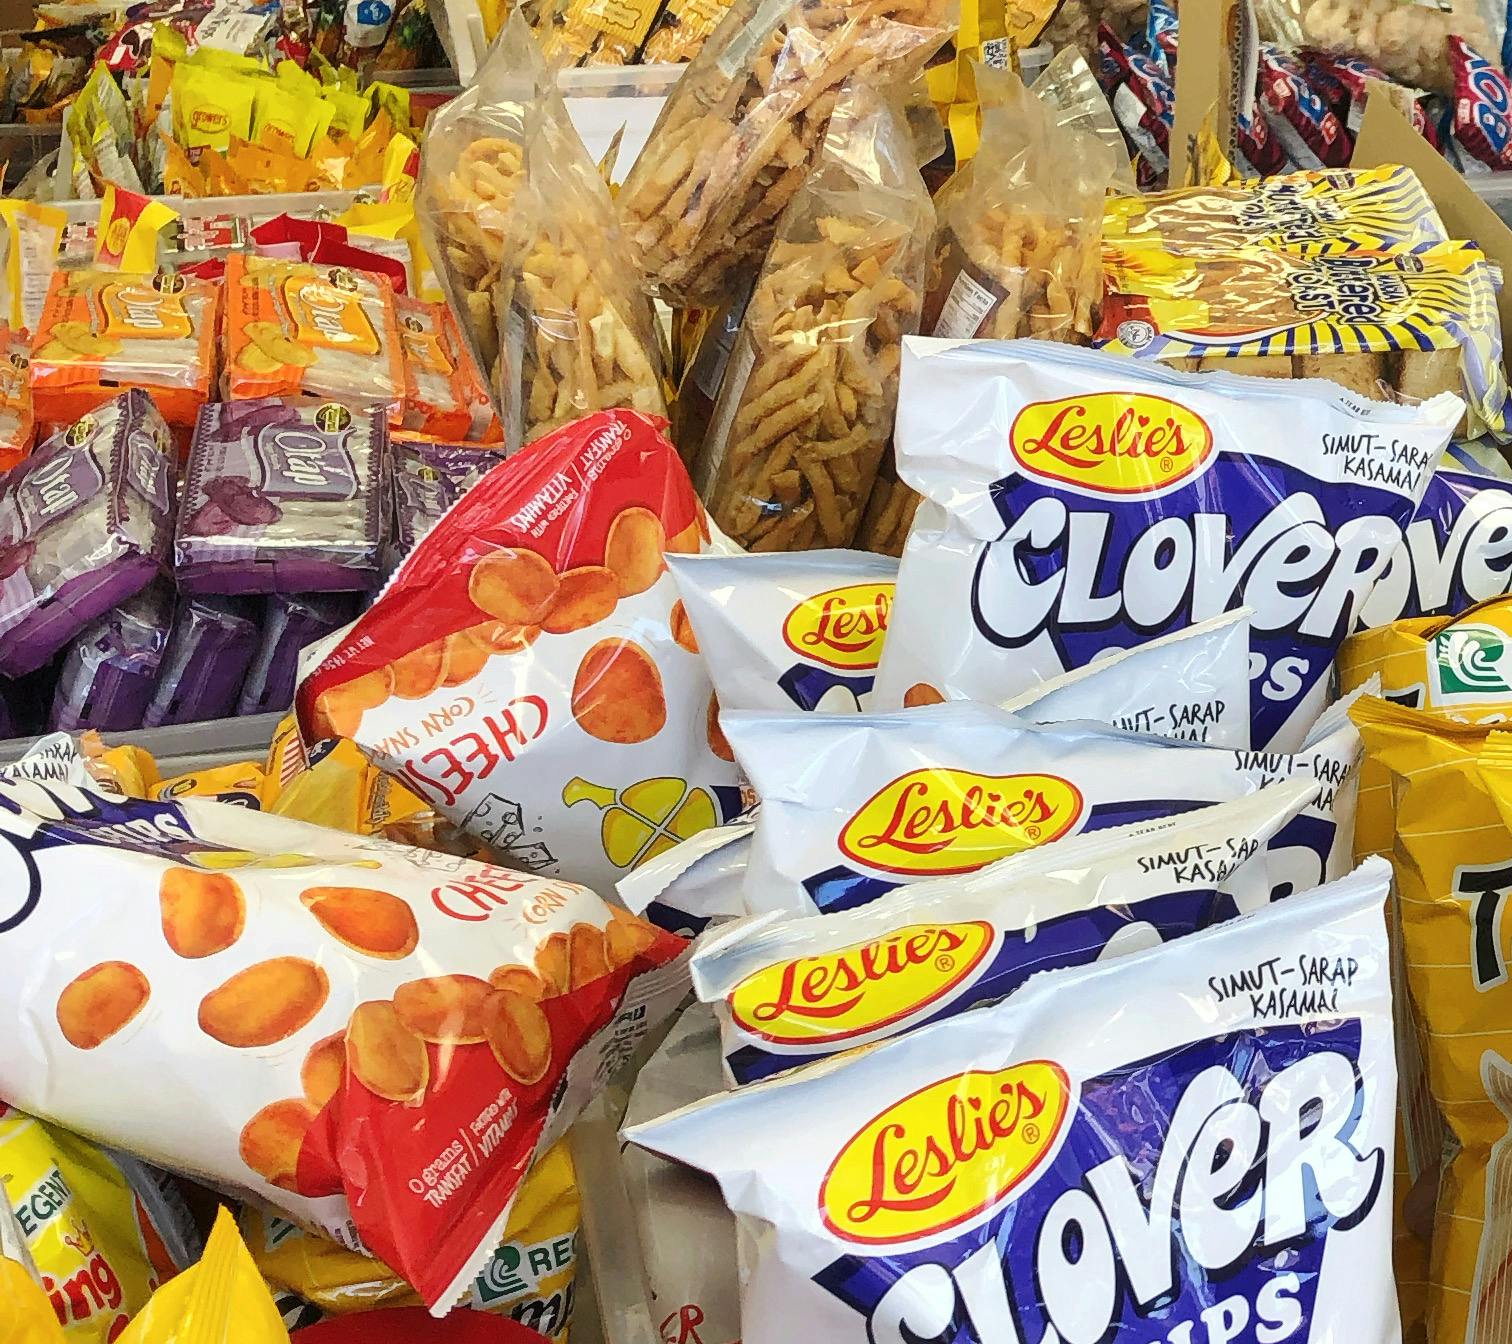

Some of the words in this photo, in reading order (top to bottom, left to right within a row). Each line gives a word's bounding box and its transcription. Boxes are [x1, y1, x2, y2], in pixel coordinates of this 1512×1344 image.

[190, 109, 230, 130] growers
[580, 420, 628, 471] TRANSFAT
[1018, 402, 1193, 476] Leslie's
[1320, 432, 1434, 472] SIMUT-SARA
[510, 472, 573, 534] VITAMINS
[803, 587, 894, 664] Lesl
[424, 695, 477, 743] CORN
[403, 691, 550, 807] CHEES
[1233, 748, 1352, 786] SIMUT-SARA
[856, 780, 1061, 855] Leslie's
[751, 927, 970, 1026] Leslie's
[1206, 953, 1360, 1005] SIMUT-SARAP
[1247, 985, 1341, 1020] KASAMA!
[478, 1104, 519, 1159] VITAMINS
[848, 1072, 1048, 1226] Leslie's
[424, 1141, 466, 1191] grams
[424, 1162, 473, 1209] TRANSFAT
[14, 1165, 68, 1238] EGENT
